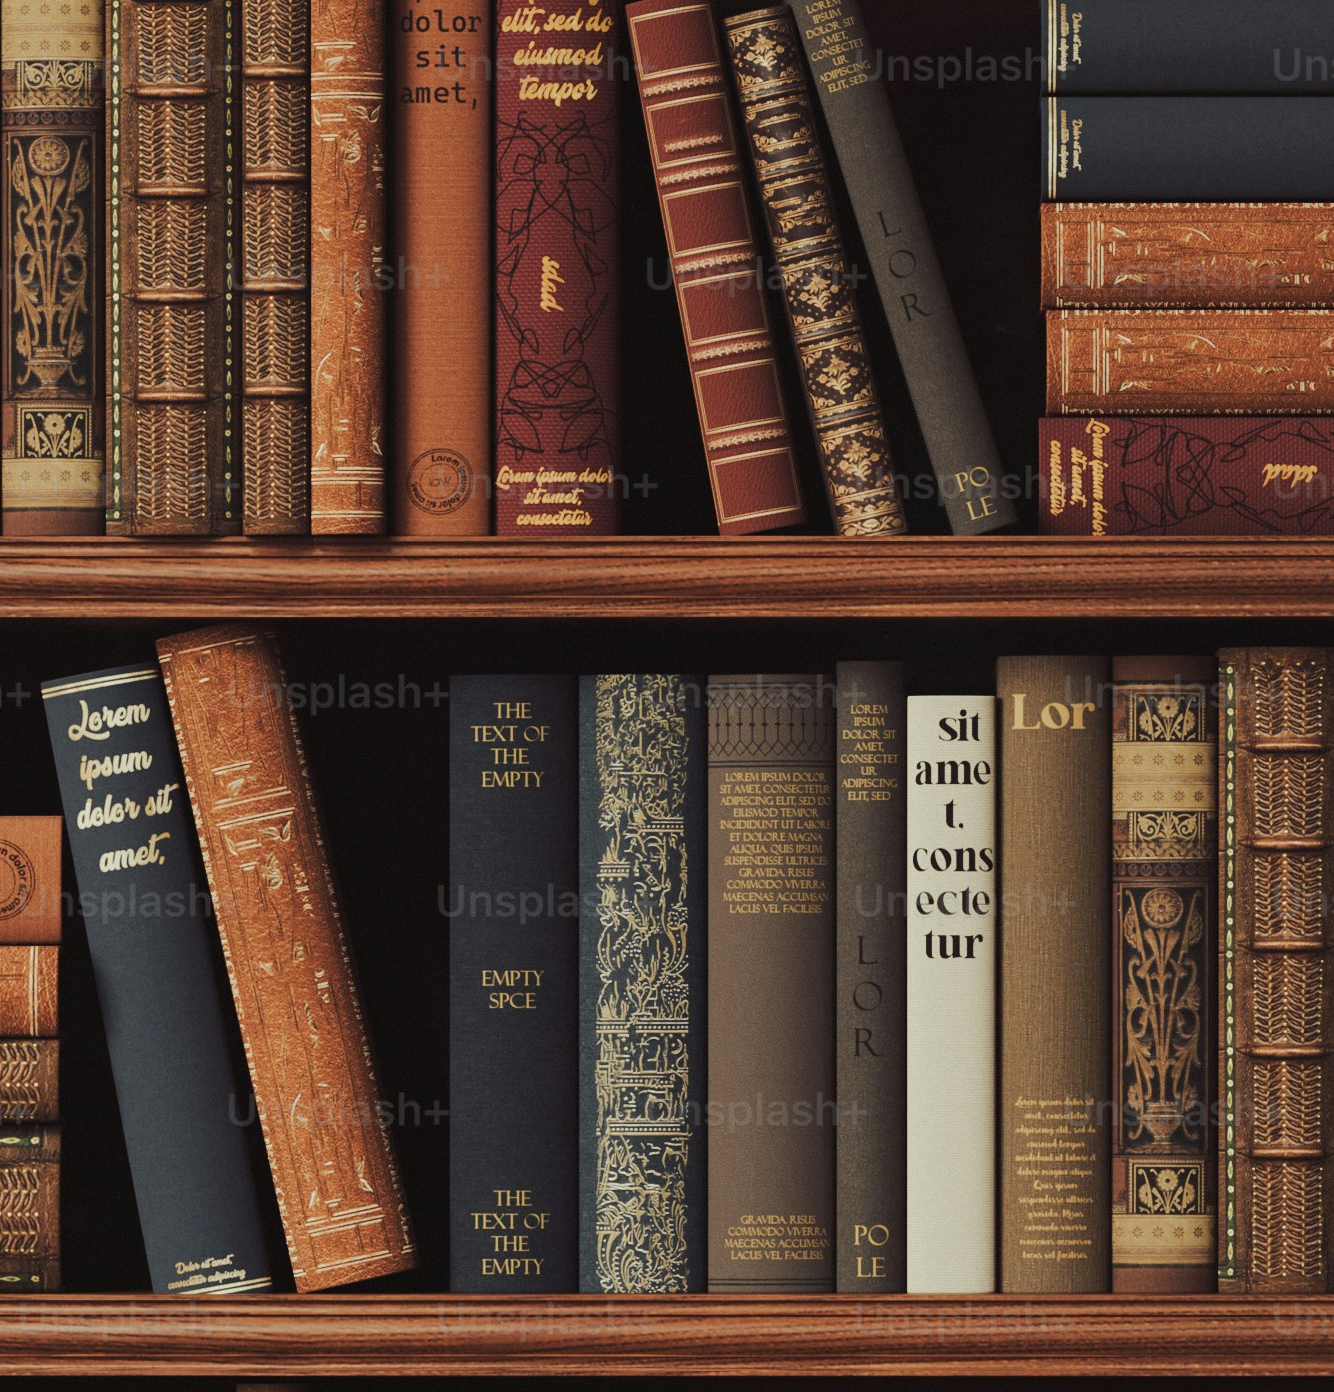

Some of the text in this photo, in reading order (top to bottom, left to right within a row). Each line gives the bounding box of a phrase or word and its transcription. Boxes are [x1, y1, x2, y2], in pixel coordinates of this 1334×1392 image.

[502, 6, 612, 34] elit, sed do
[512, 40, 602, 66] eiusmod
[519, 74, 597, 107] tempor
[540, 256, 565, 312] sdad
[493, 702, 531, 719] THE
[1008, 693, 1094, 734] Lor
[471, 725, 549, 742] TEXT OF
[939, 709, 980, 741] sit
[491, 748, 529, 764] THE
[482, 771, 542, 788] EMPTY
[916, 757, 994, 788] ame
[945, 800, 963, 828] t.
[913, 844, 996, 875] cons
[916, 887, 991, 915] ecte
[926, 931, 983, 959] tur
[482, 970, 542, 987] EMPTY
[489, 992, 536, 1009] SPCE
